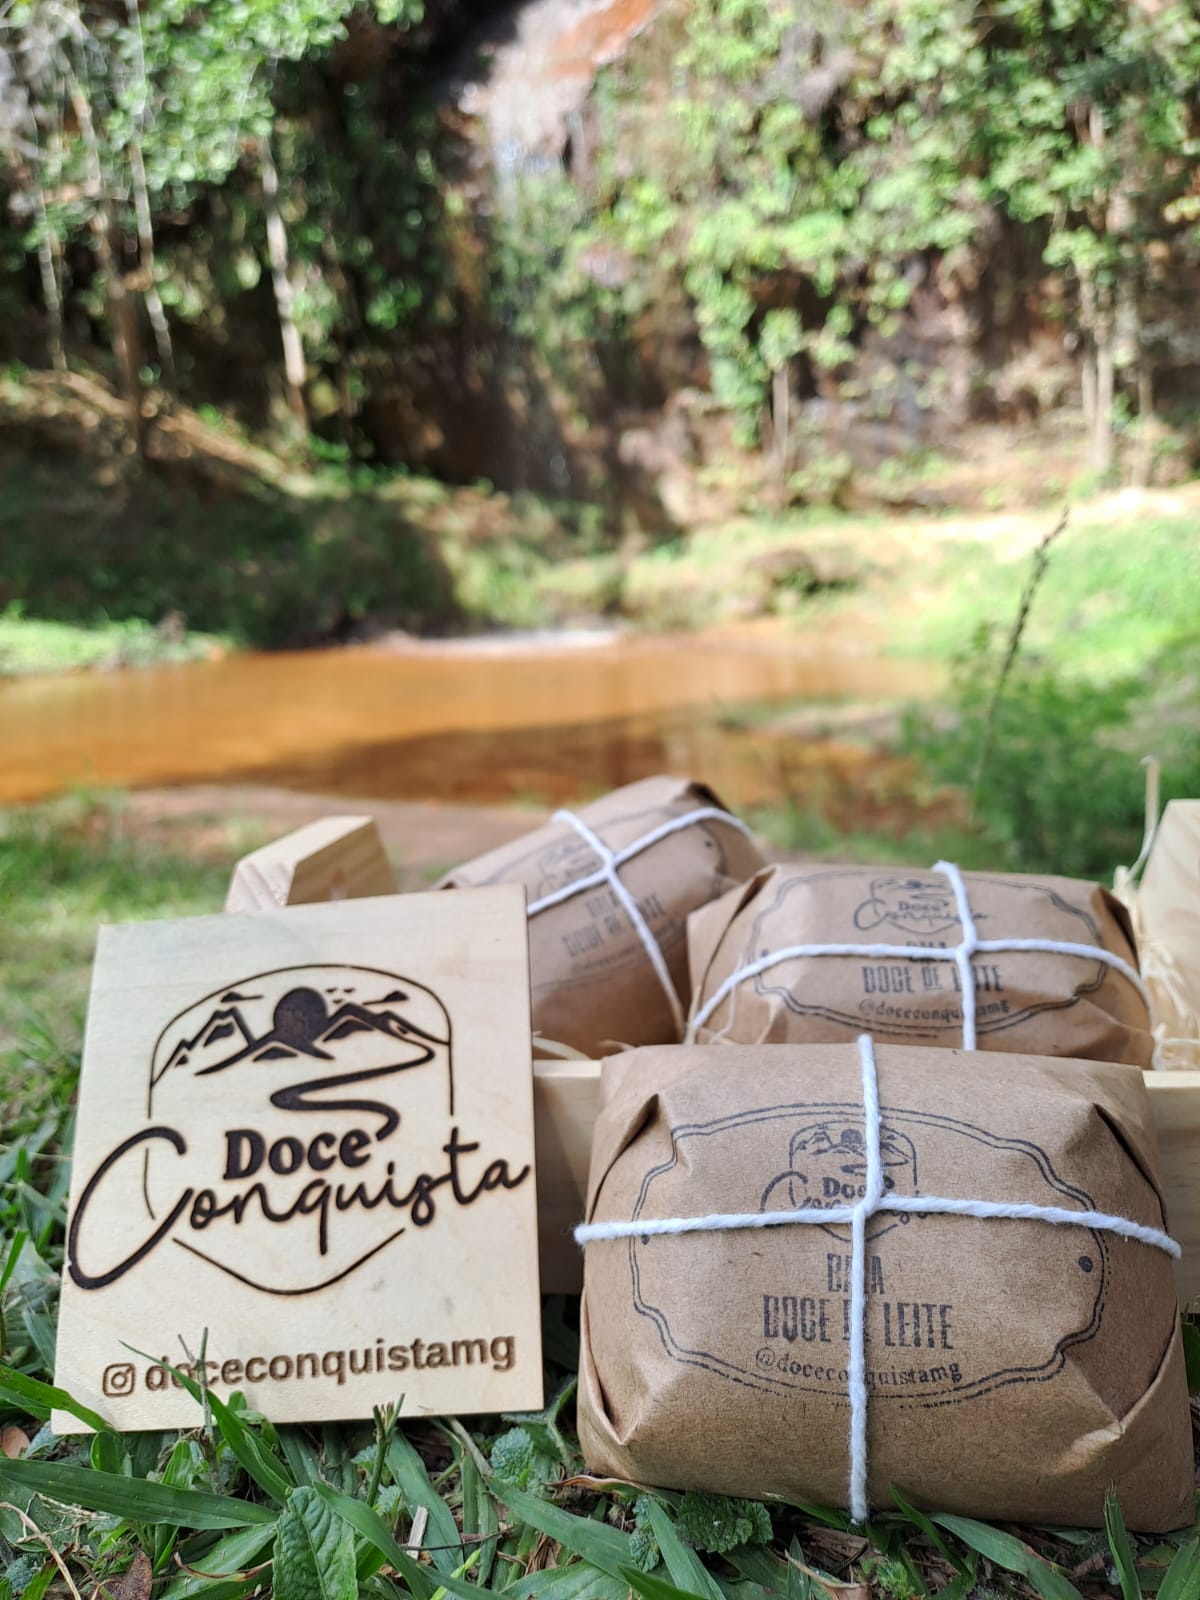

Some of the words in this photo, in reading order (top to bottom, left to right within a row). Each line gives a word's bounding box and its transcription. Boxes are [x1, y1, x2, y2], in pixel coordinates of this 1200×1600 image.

[68, 1126, 531, 1290] Conquista
[763, 1295, 832, 1342] DOCE
[883, 1302, 954, 1349] LEITE
[755, 1347, 963, 1391] @docecoquistamg
